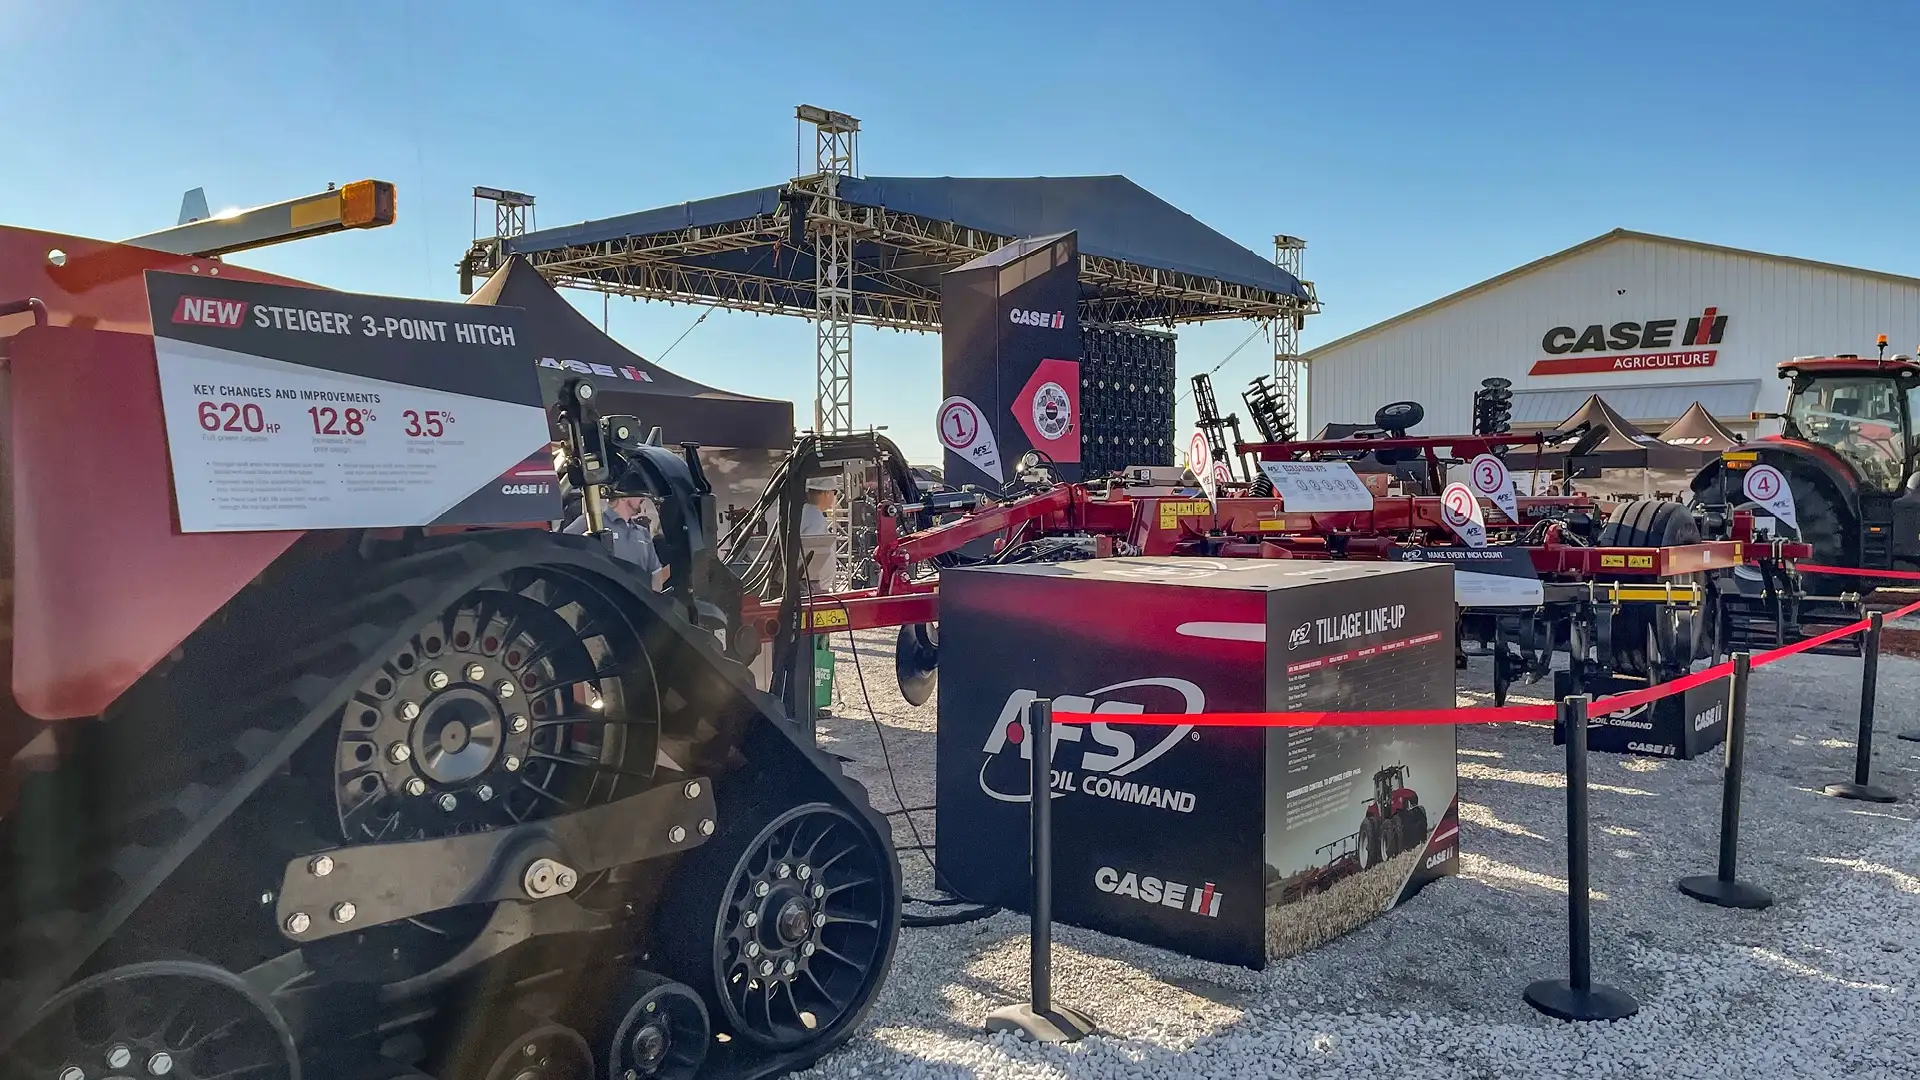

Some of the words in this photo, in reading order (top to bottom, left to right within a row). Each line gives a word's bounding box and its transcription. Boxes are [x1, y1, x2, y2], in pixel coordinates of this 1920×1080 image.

[183, 298, 242, 325] NEW
[361, 315, 447, 342] 3-POINT
[454, 322, 516, 346] HITCH
[1010, 308, 1050, 327] CASE
[1541, 319, 1677, 355] CASE
[535, 357, 618, 378] ASE
[1613, 352, 1711, 370] AGRICULTURE
[193, 384, 215, 396] KEY
[219, 386, 271, 398] CHANGES
[275, 389, 297, 400] AND
[300, 390, 381, 404] IMPROVEMENTS
[308, 406, 377, 436] 12.8%
[402, 410, 456, 437] 3.5%
[952, 413, 966, 437] 1
[973, 445, 987, 456] AFS
[1195, 443, 1201, 465] 1
[1482, 467, 1493, 485] 3
[1758, 476, 1770, 492] 4
[502, 484, 537, 495] CASE
[1453, 497, 1463, 517] 2
[1527, 505, 1550, 516] CASE
[1289, 627, 1306, 643] AFS
[1316, 612, 1361, 645] TILLAGE
[1365, 605, 1406, 635] LINE-UP
[1590, 717, 1608, 726] SOIL
[1610, 718, 1653, 730] COMMAND
[1694, 711, 1714, 732] CASE
[1627, 741, 1662, 754] CASE
[1050, 770, 1076, 792] OIL
[1082, 775, 1197, 814] COMMAND
[1426, 852, 1445, 869] CASE
[1094, 867, 1188, 910] CASE
